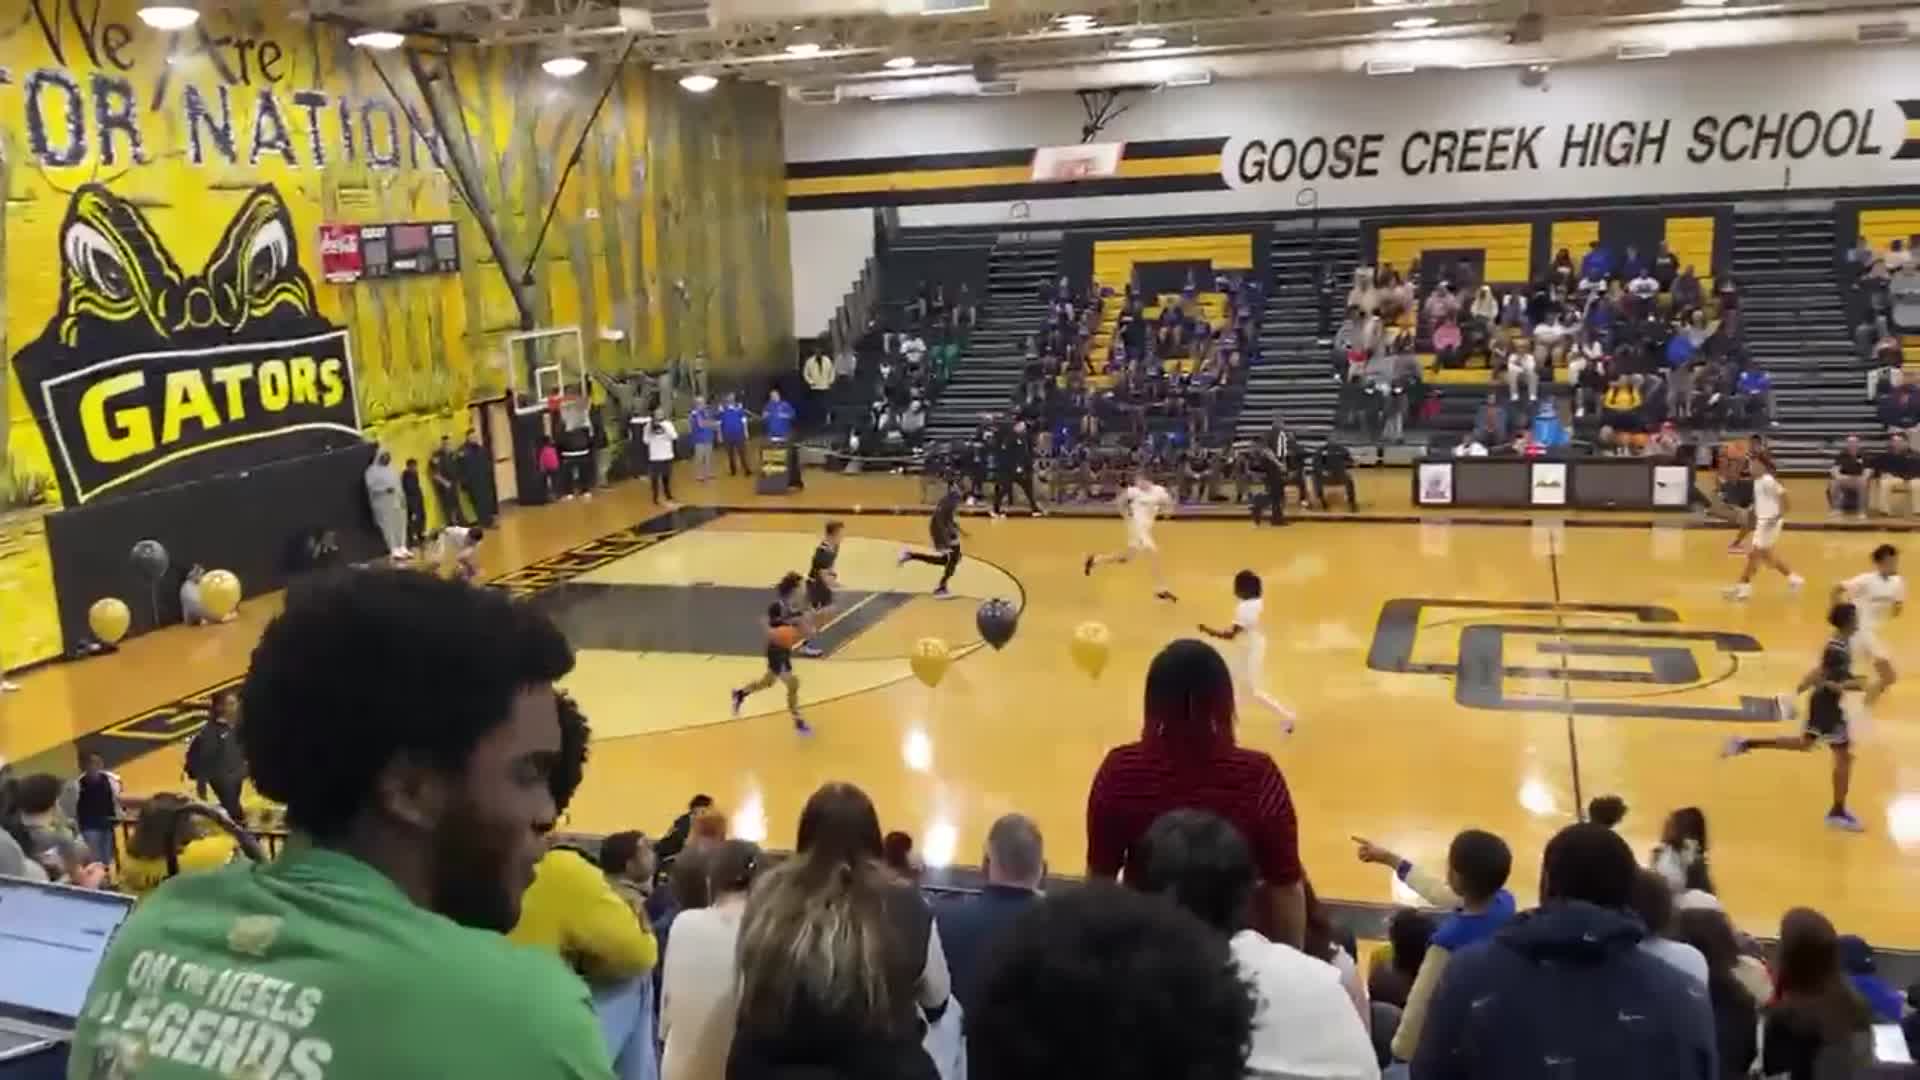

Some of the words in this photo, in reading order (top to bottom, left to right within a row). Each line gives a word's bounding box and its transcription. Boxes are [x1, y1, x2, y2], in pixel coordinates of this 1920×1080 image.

[0, 66, 145, 167] OR
[1238, 133, 1385, 184] GOOSE
[1401, 125, 1546, 176] CREEK
[1559, 118, 1671, 168] HIGH
[1687, 108, 1882, 164] SCHOOL
[79, 355, 346, 464] GATORS
[127, 951, 178, 993] ON
[205, 968, 324, 1029] HEELS
